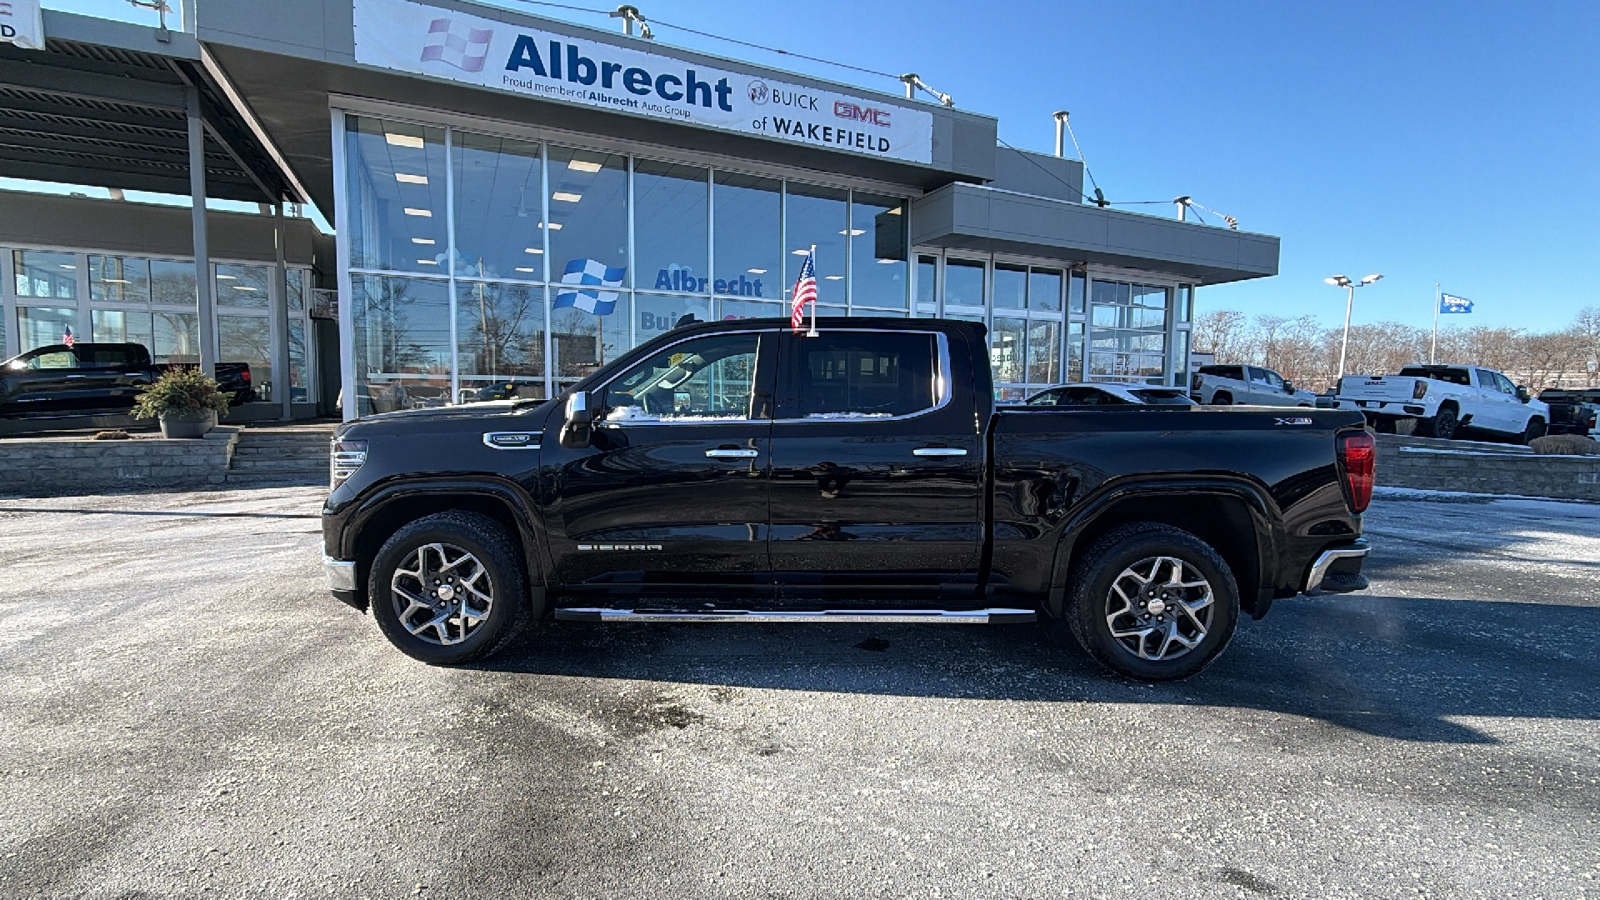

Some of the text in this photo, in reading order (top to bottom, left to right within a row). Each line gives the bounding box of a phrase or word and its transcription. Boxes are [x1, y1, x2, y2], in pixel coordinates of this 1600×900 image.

[505, 34, 733, 112] Albrecht
[503, 75, 691, 118] Proud member of Albrecht Auto Group
[772, 88, 891, 128] BUICK GMC
[752, 116, 890, 153] of WAKEFIELD
[654, 269, 763, 297] Albrecht
[641, 311, 678, 331] Bui
